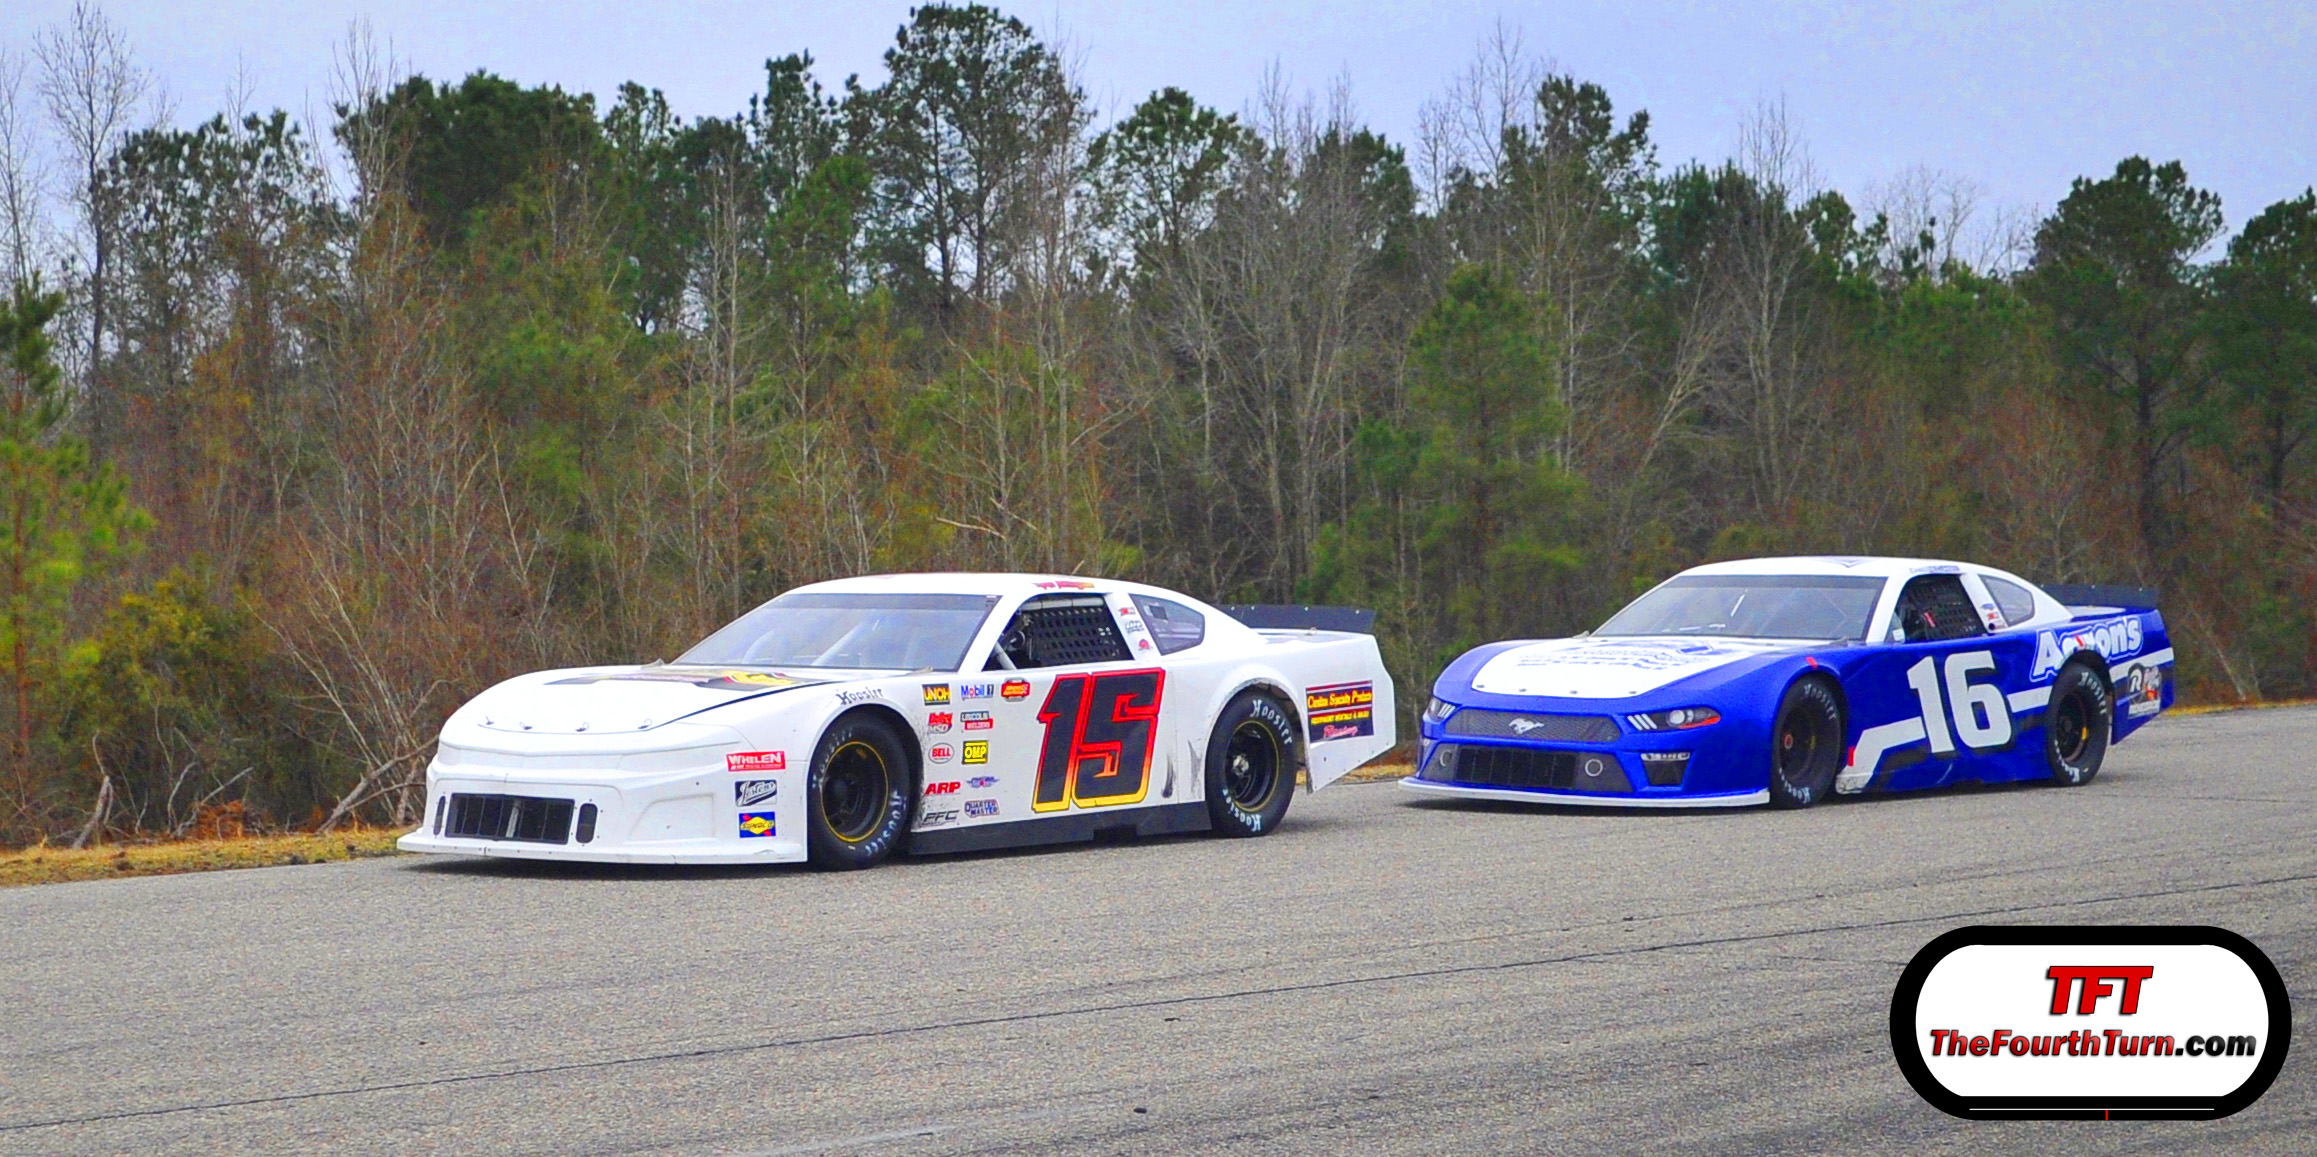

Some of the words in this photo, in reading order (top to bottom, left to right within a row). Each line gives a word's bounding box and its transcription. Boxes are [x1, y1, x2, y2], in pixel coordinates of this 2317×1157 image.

[835, 686, 884, 705] Hoosier
[925, 686, 951, 700] UNOH
[961, 684, 985, 697] Mobil
[1906, 650, 2012, 754] 16
[1250, 699, 1293, 745] Hoosier
[1032, 667, 1166, 813] 15
[728, 752, 782, 765] WHELEN
[931, 747, 951, 757] BELL
[964, 746, 987, 759] OMP
[925, 782, 961, 795] ARP
